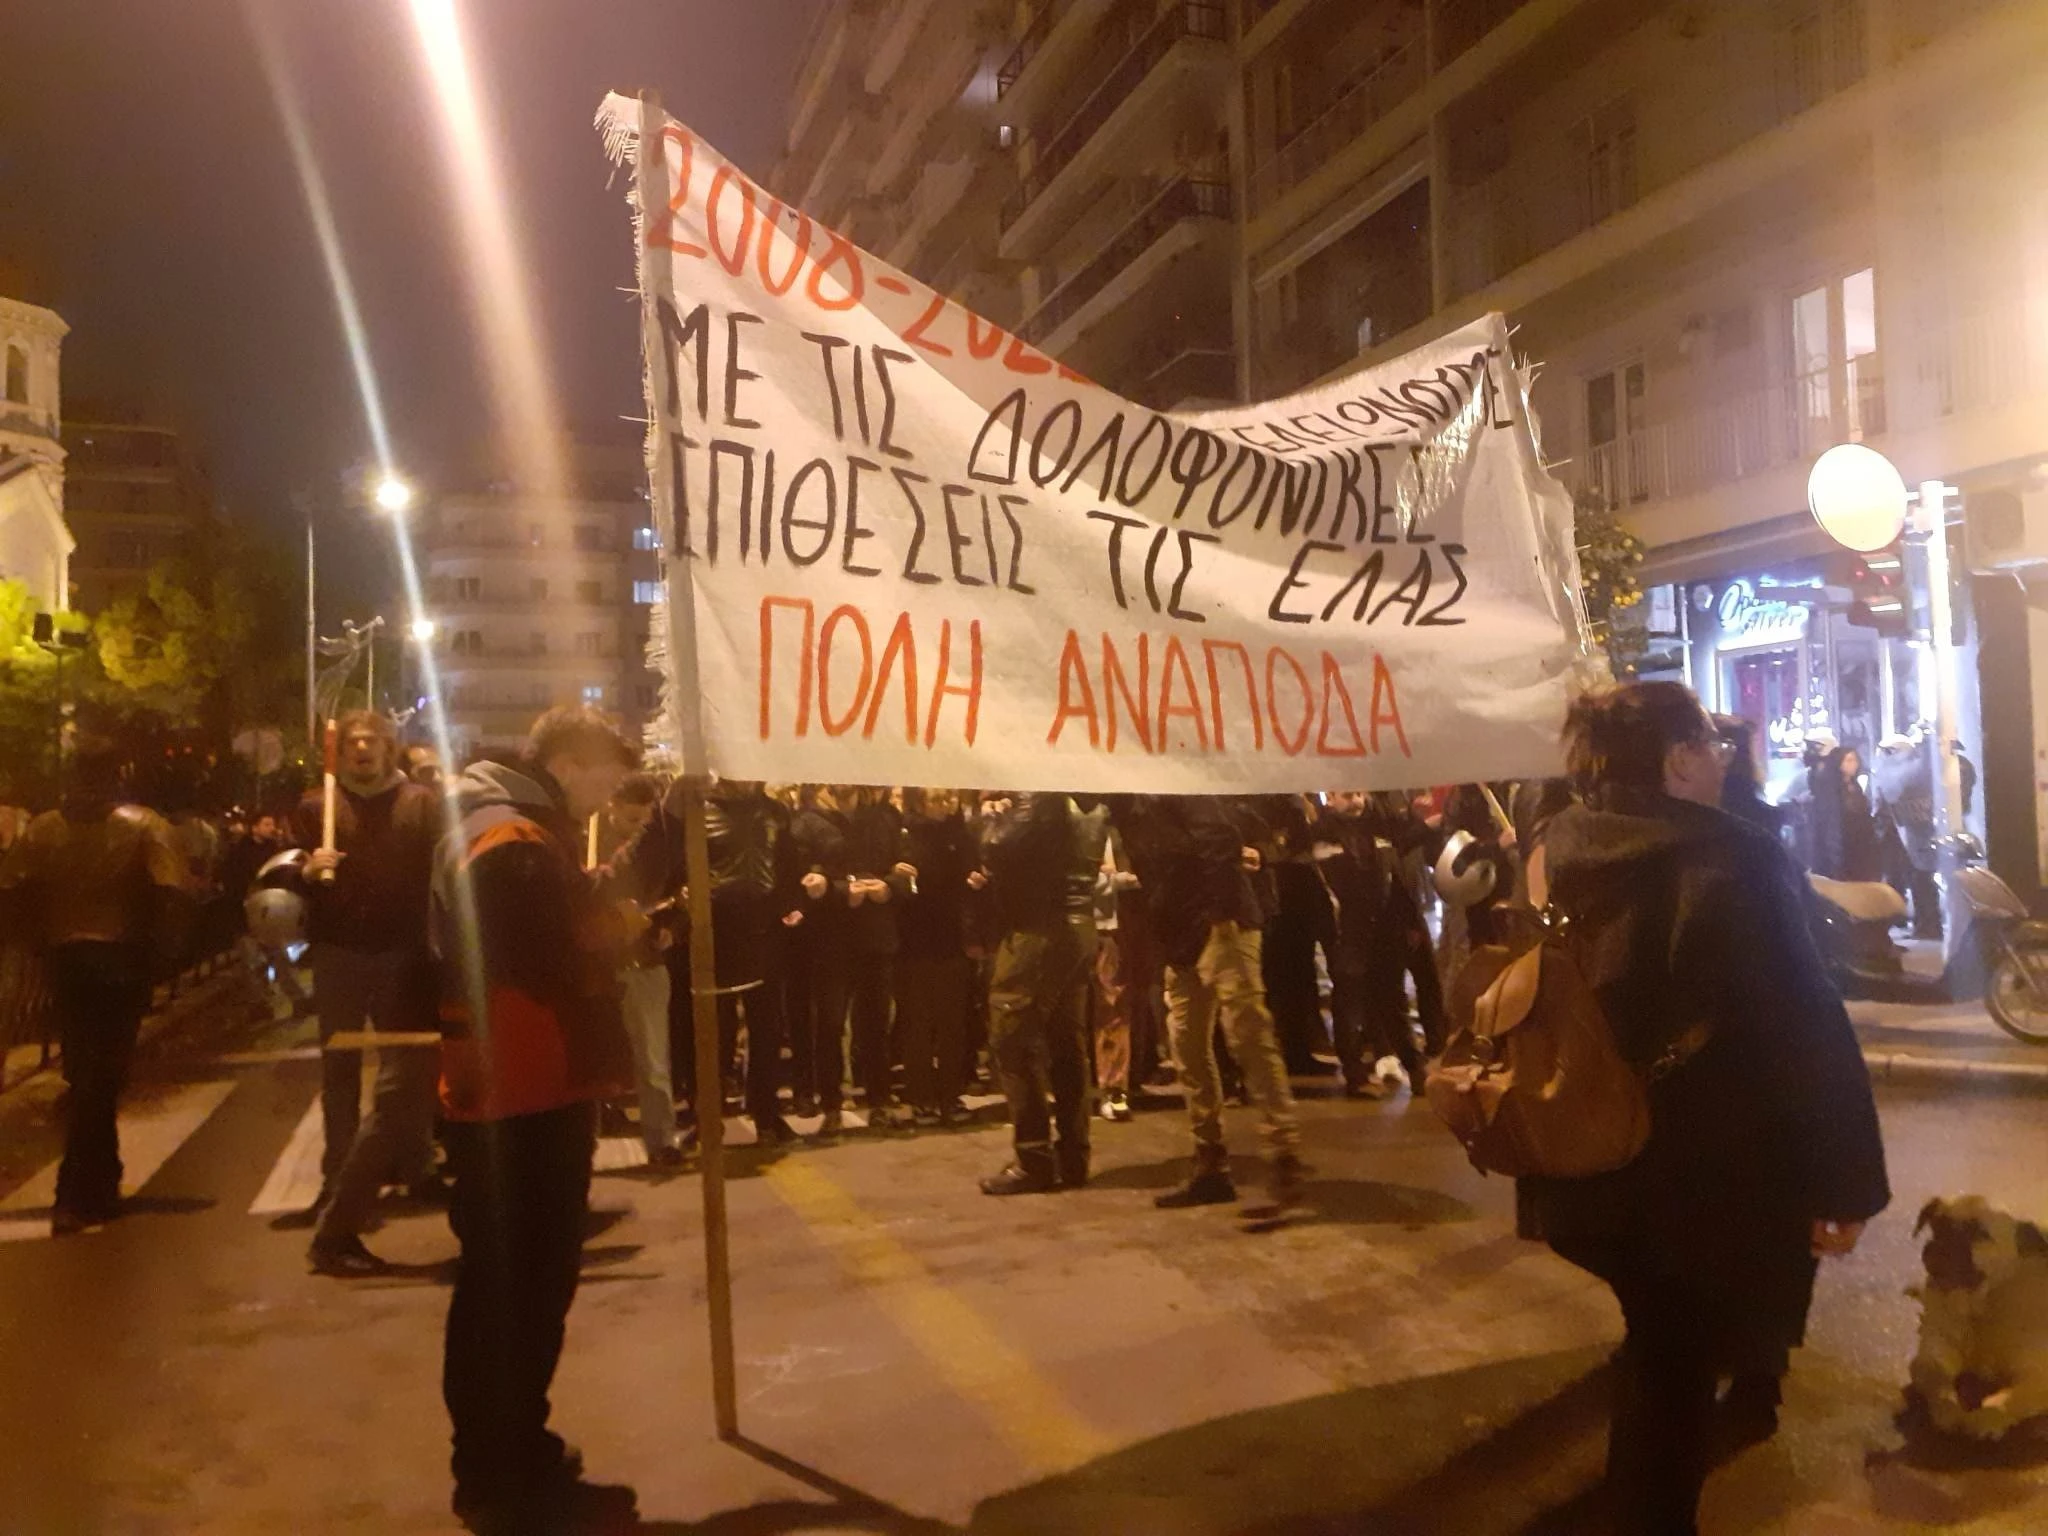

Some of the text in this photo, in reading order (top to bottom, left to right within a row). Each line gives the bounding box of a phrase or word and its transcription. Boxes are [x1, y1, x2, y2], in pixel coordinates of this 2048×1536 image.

[657, 301, 1436, 544] ΜΕ ΤΙΣ ΔΟΛΟΦΟΝΙΚΕΣ
[670, 431, 1469, 627] ΕΠΙΘΕΣΕΙΣ ΤΙΣ ΕΛΑΣ
[759, 594, 1412, 758] ΠΟΛΗ ΑΝΑΠΟΔΑ
